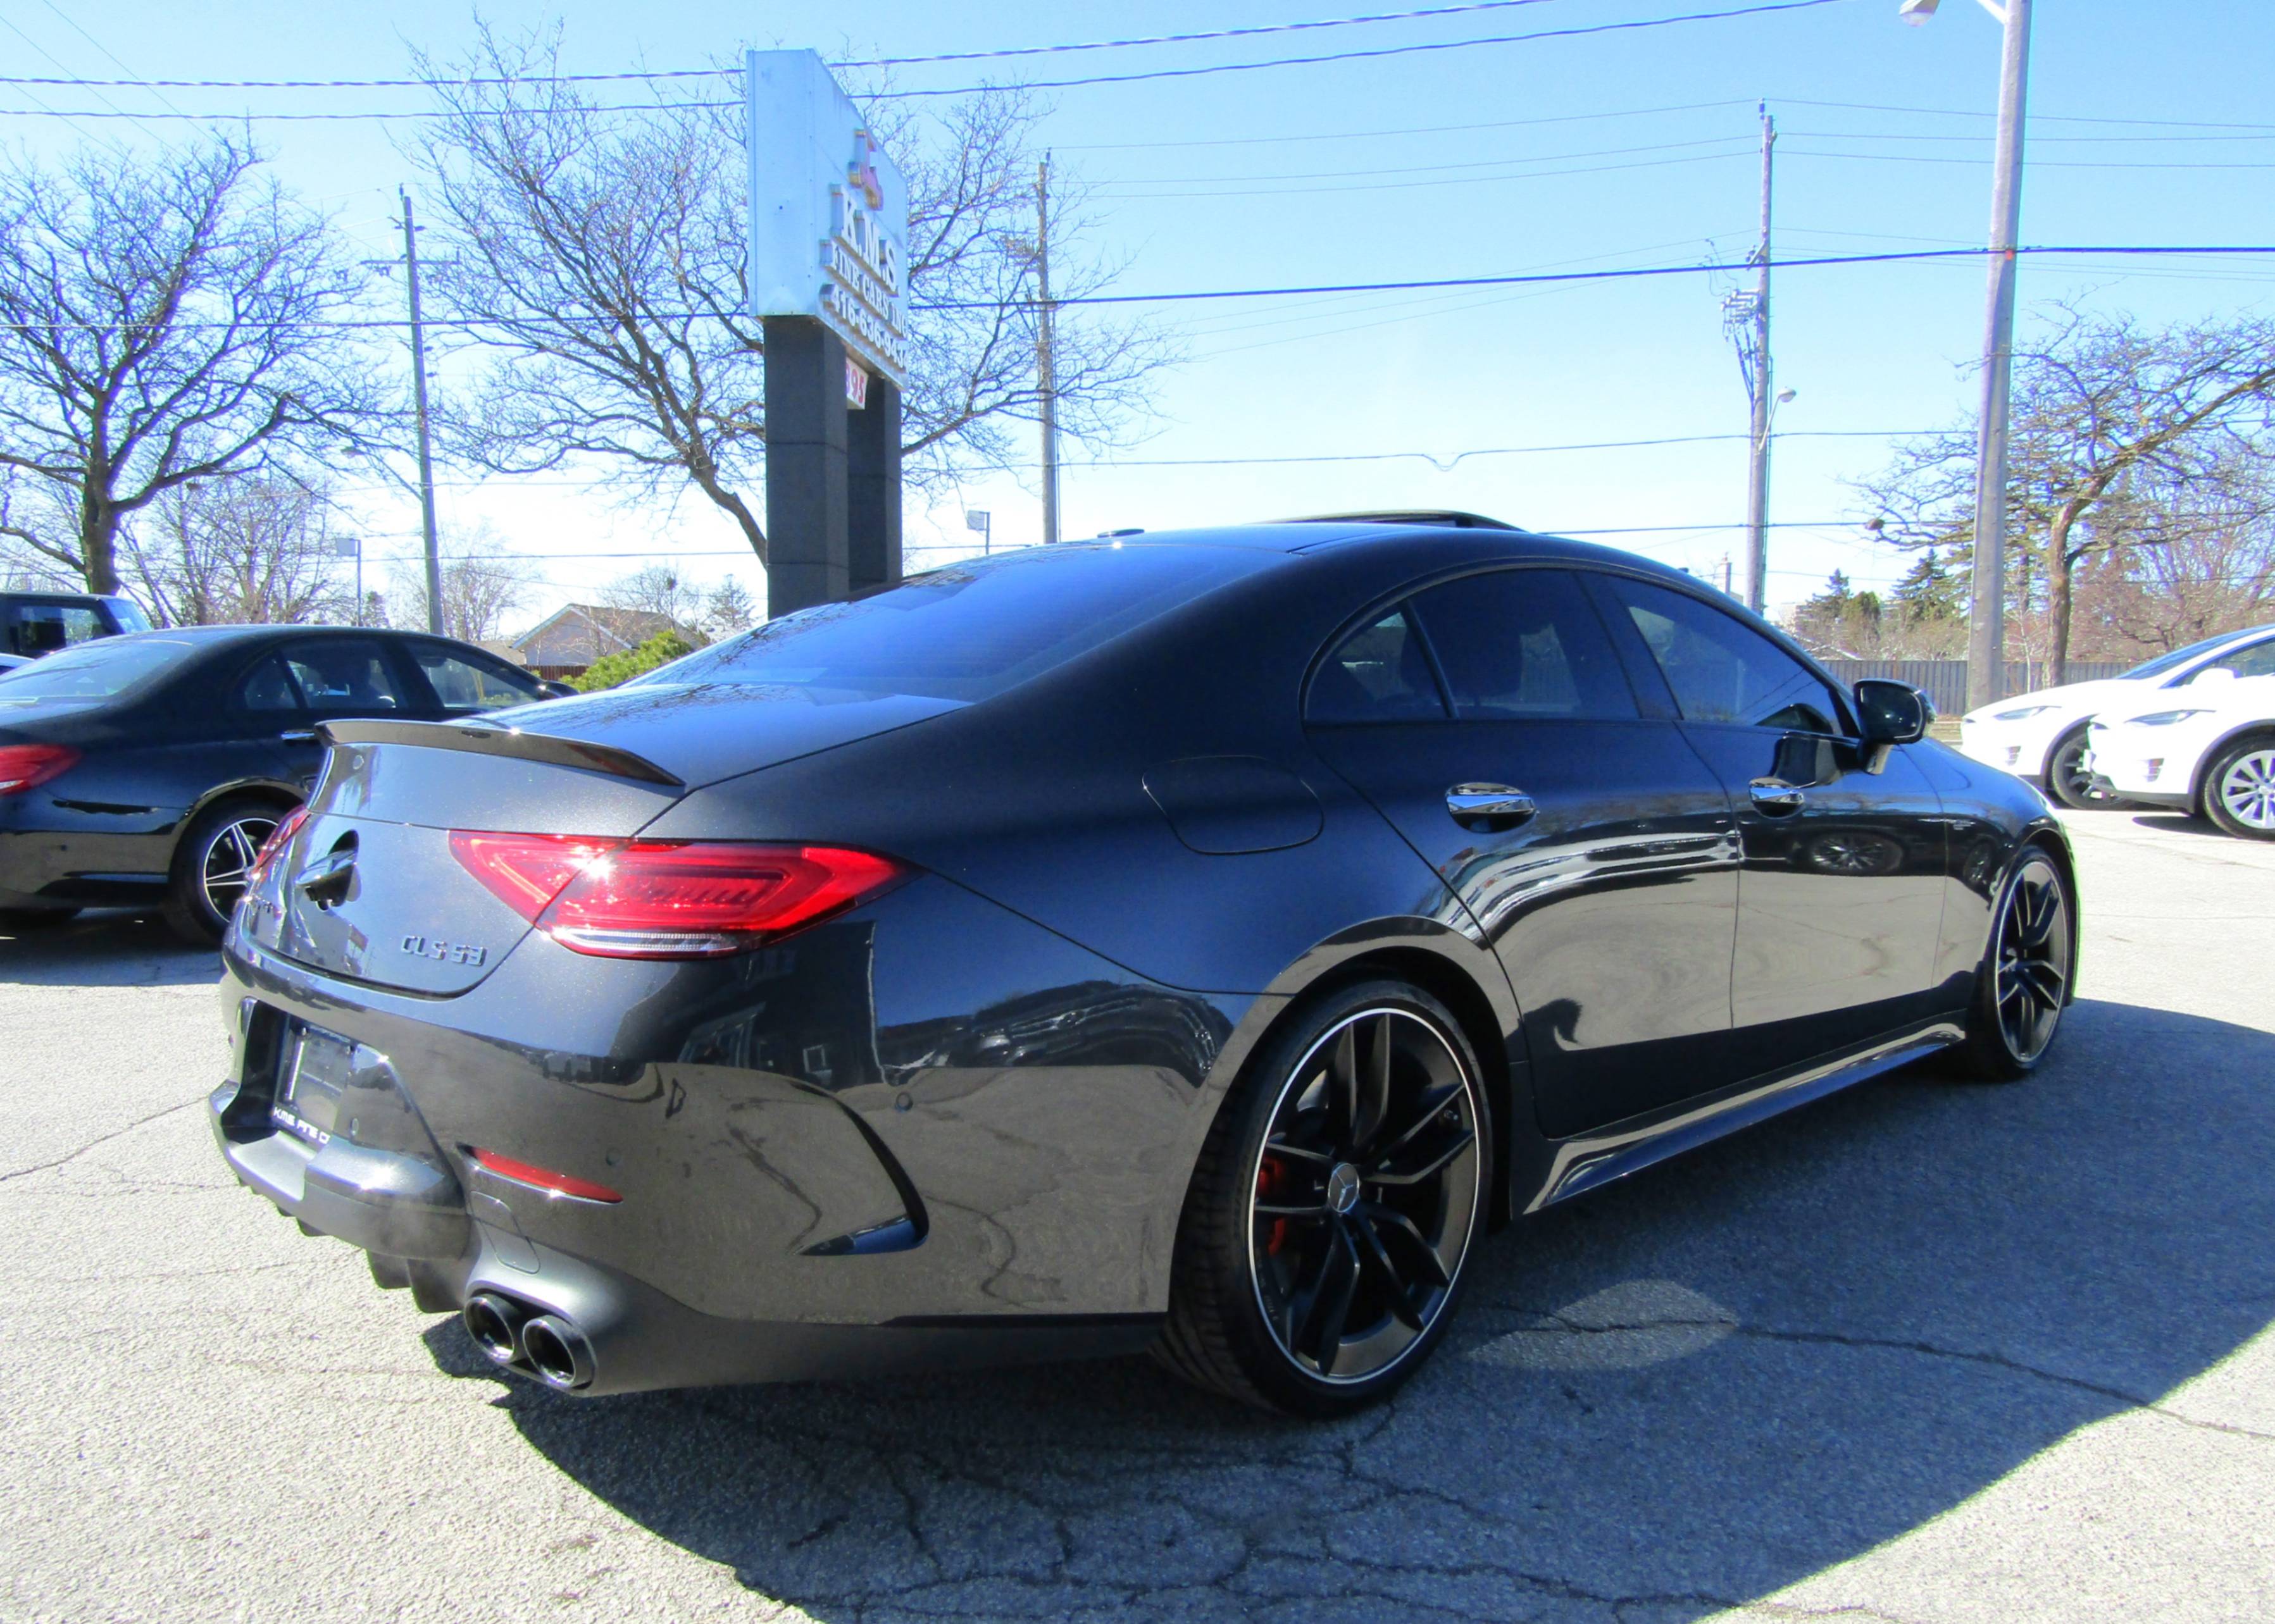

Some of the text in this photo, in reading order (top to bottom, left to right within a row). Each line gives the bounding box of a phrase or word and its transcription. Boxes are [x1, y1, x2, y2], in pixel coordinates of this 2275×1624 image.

[830, 240, 860, 292] FINE
[862, 274, 889, 321] CARS
[831, 283, 910, 373] 416-636-9434
[401, 935, 487, 967] CLS 53
